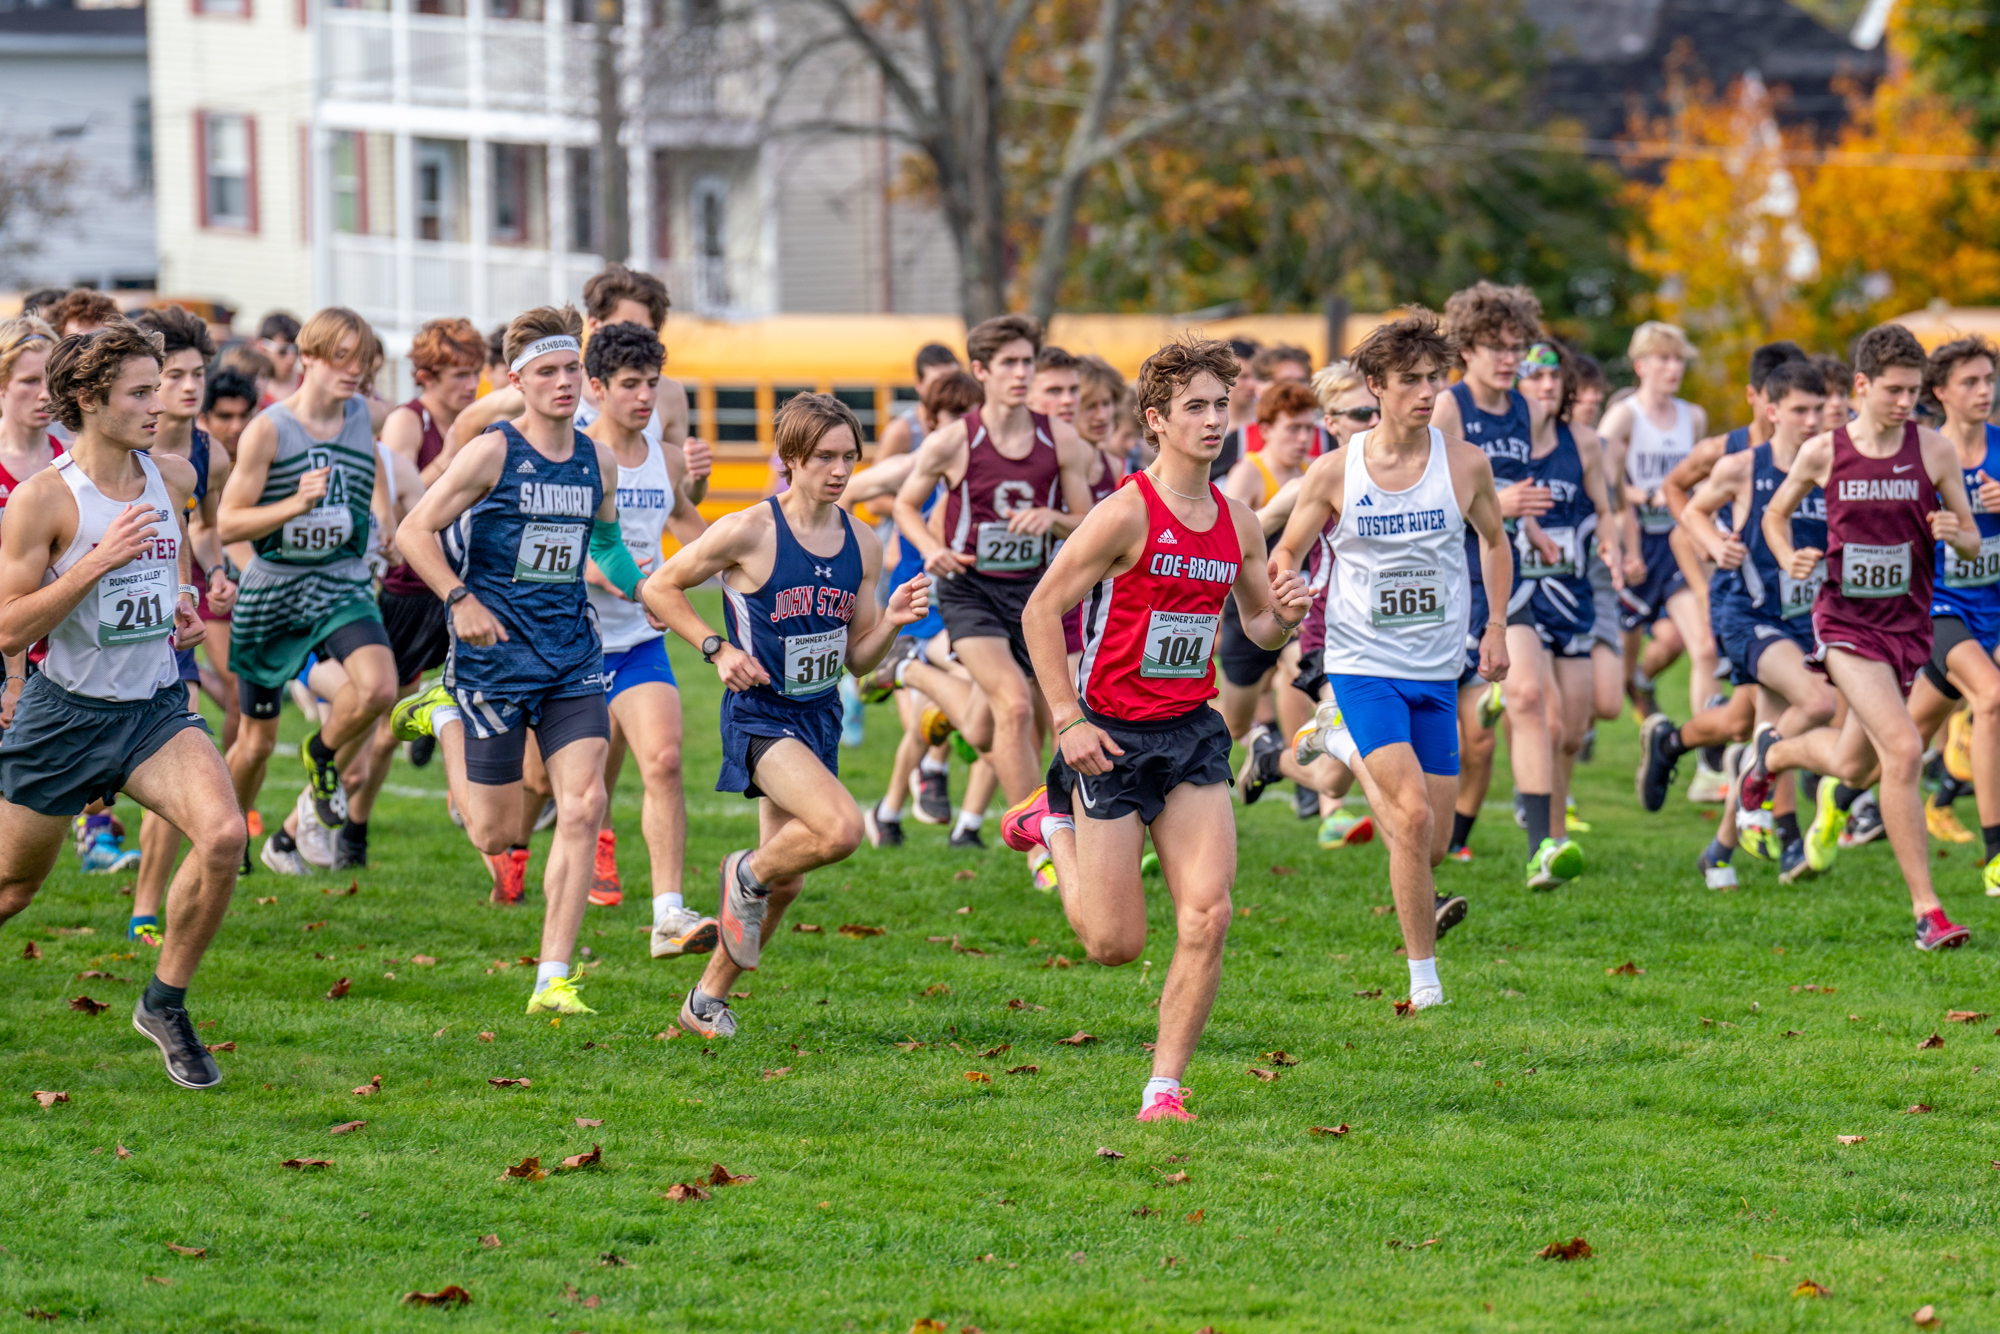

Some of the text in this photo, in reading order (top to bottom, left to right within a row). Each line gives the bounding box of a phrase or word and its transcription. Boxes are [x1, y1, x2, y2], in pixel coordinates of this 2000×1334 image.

[535, 340, 574, 353] SANBORN
[519, 481, 594, 519] SANBORN
[636, 488, 666, 509] RIVER
[993, 480, 1035, 519] G
[1838, 479, 1920, 501] LEBANON
[532, 523, 579, 533] RUNNER'S ALLEY
[1357, 508, 1447, 537] OYSTER RIVER
[291, 526, 344, 550] 595
[1157, 537, 1178, 545] adidas
[531, 543, 572, 573] 715
[987, 540, 1034, 562] 226
[1149, 552, 1239, 586] COE-BROWN
[1379, 569, 1437, 579] RUNNER'S ALLEY
[1852, 563, 1903, 588] 386
[1955, 552, 2000, 578] 580
[109, 569, 161, 587] RUNNER'S ALLEY
[116, 593, 164, 632] 241
[770, 585, 815, 623] JOHN
[1379, 587, 1437, 616] 565
[1159, 613, 1214, 624] RUNNER'S ALLEY
[795, 629, 843, 646] RUNNER'S ALLEY
[1157, 635, 1204, 667] 104
[796, 649, 840, 685] 316
